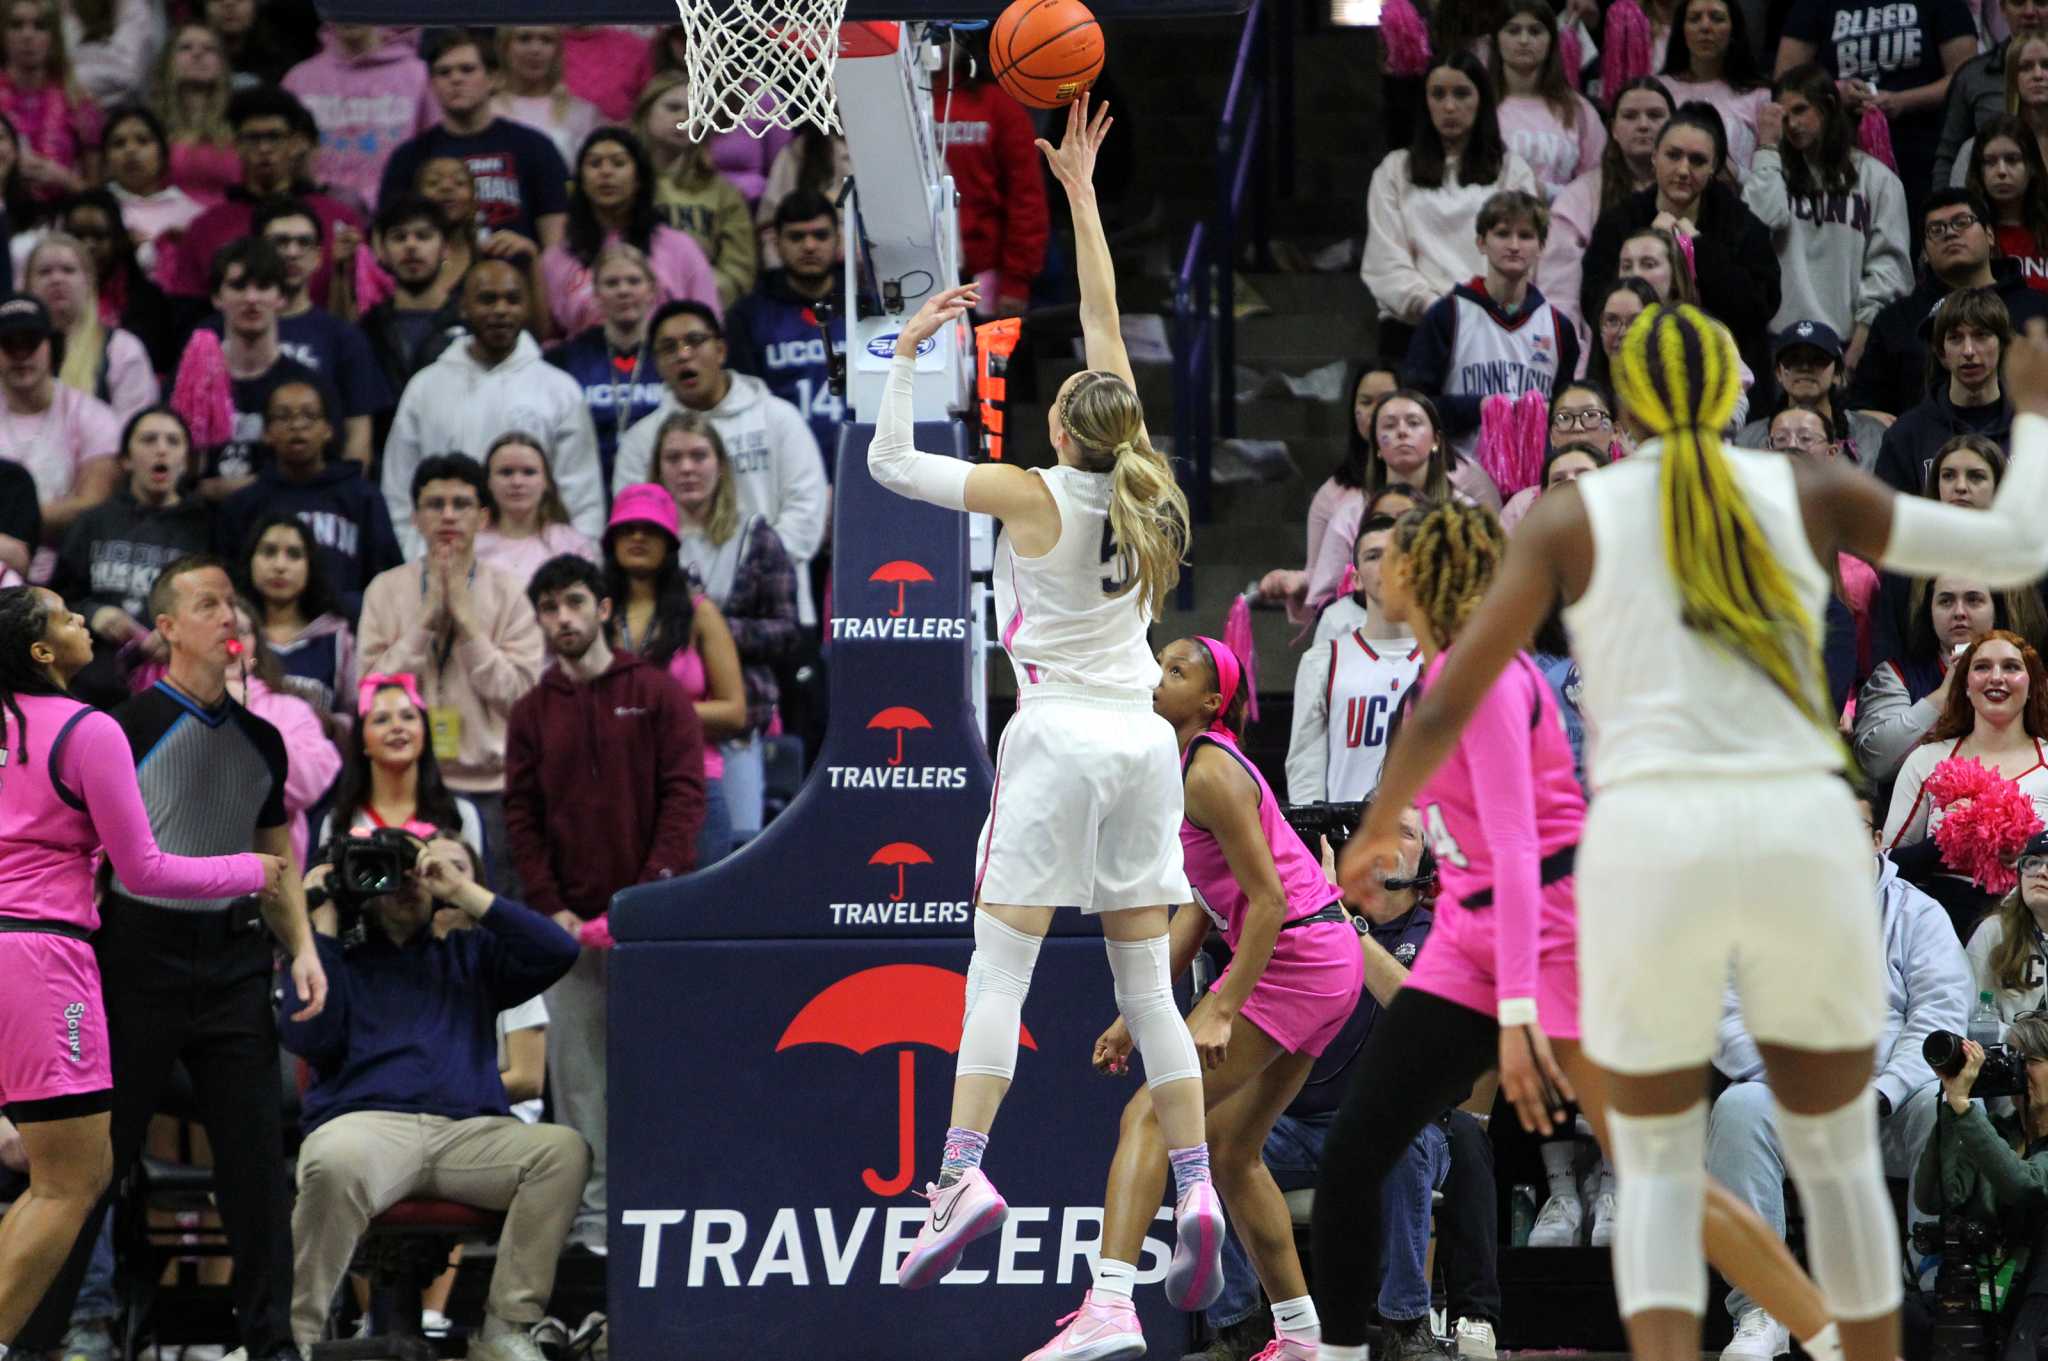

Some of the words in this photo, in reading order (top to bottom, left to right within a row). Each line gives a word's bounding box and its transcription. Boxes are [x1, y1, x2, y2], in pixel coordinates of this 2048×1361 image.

[1831, 3, 1918, 42] BLEED
[1837, 27, 1922, 79] BLUE
[796, 378, 844, 422] 14
[1462, 359, 1554, 402] CONNECTCUT
[829, 617, 966, 639] TRAVELERS
[1346, 695, 1398, 748] UC
[827, 766, 967, 788] TRAVELERS
[829, 901, 969, 924] TRAVELERS
